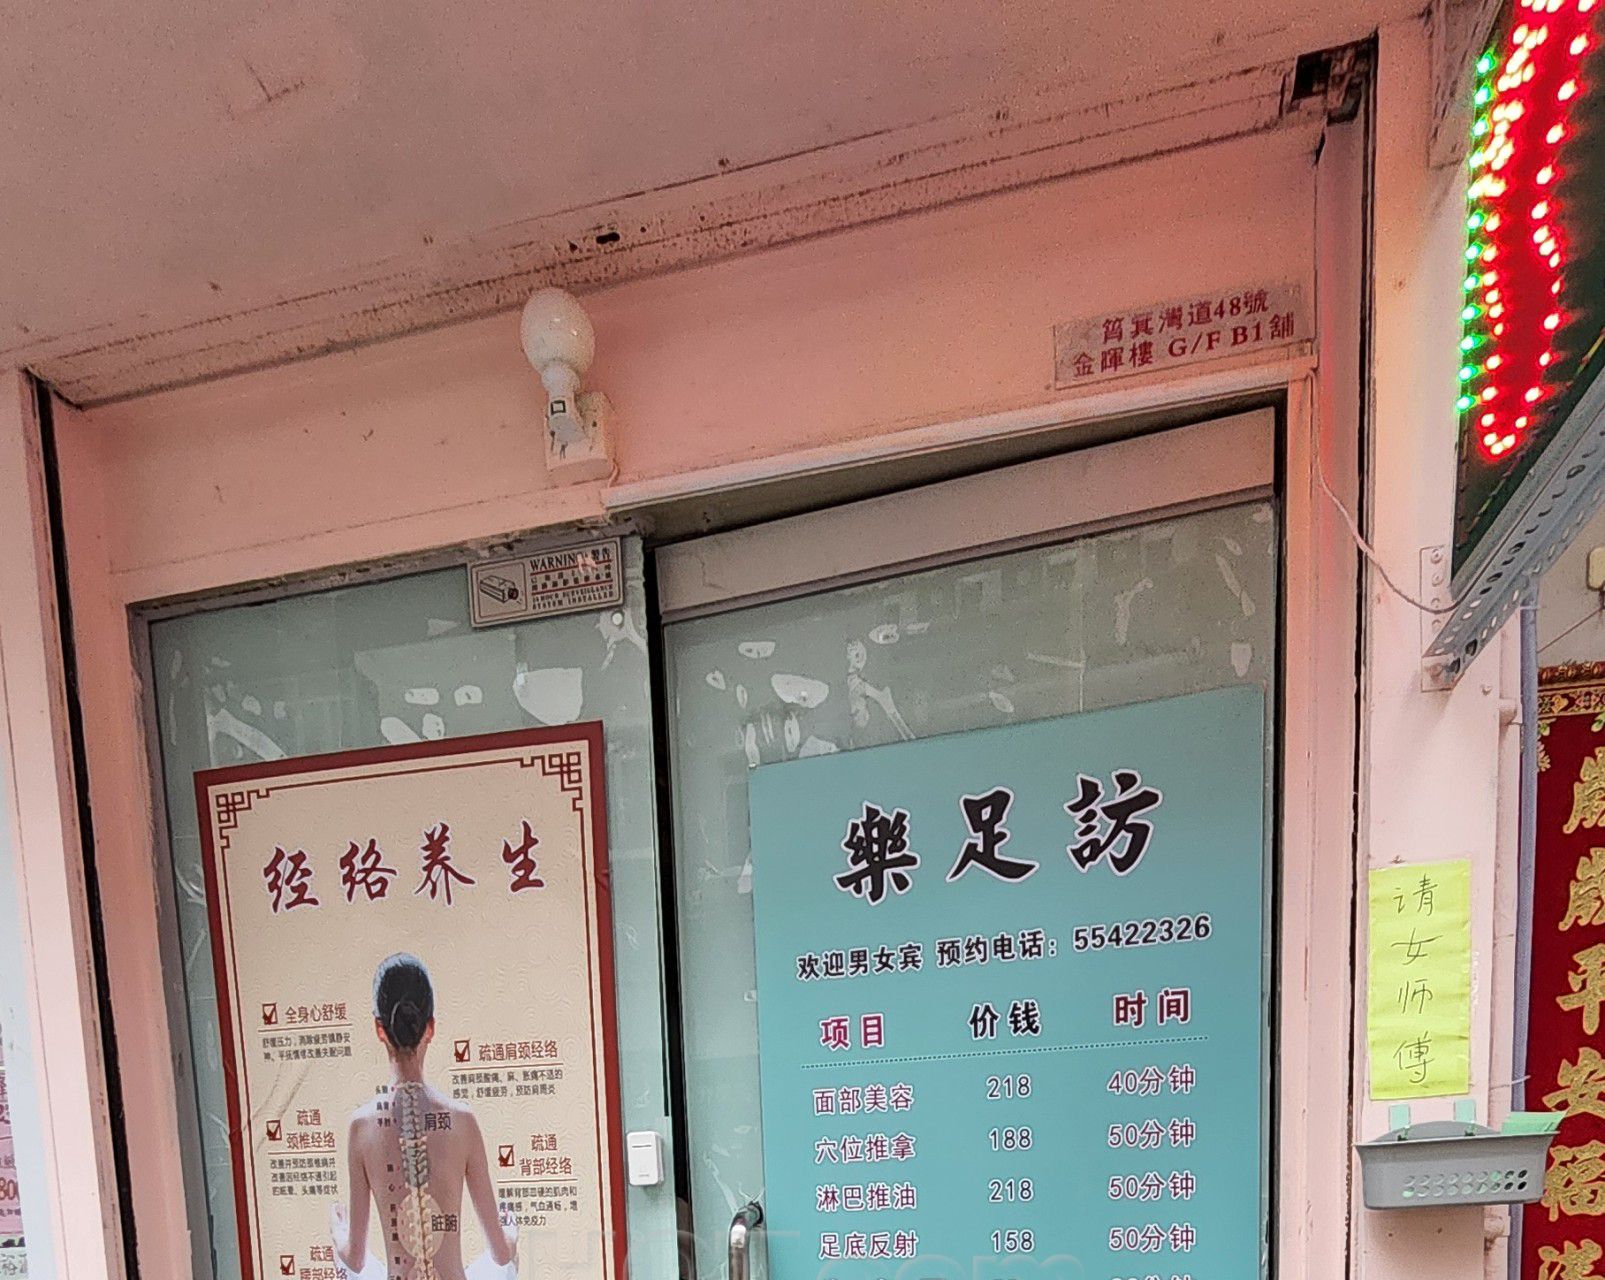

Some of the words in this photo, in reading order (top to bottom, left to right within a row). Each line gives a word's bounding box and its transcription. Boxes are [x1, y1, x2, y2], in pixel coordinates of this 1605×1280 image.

[1101, 288, 1270, 345] 筲箕灣道48號
[1072, 340, 1154, 378] 金暉樓
[1167, 330, 1221, 359] G/F
[832, 768, 1164, 906] 樂足訪
[262, 818, 546, 914] 经络养生
[796, 942, 924, 981] 欢迎男女宾
[1072, 913, 1212, 953] 55422326
[1390, 873, 1443, 1085] 请女师傅
[284, 1002, 348, 1024] 全身心舒缓
[818, 1013, 886, 1051] 项目
[968, 1000, 1043, 1040] 价钱
[1112, 987, 1191, 1028] 时间
[478, 1040, 559, 1062] 疏通肩颈经络
[812, 1083, 915, 1116] 面部美容
[985, 1074, 1032, 1099] 218
[1106, 1063, 1198, 1096] 40分钟
[296, 1108, 322, 1127] 疏通
[424, 1112, 452, 1131] 肩颈
[286, 1131, 336, 1150] 颈椎经络
[530, 1134, 558, 1152] 疏通
[814, 1132, 917, 1164] 穴位推拿
[988, 1127, 1034, 1152] 188
[1107, 1117, 1198, 1149] 50分钟
[519, 1158, 573, 1176] 背部经络
[816, 1182, 918, 1213] 淋巴推油
[988, 1178, 1035, 1204] 218
[1107, 1170, 1198, 1201] 50分钟
[431, 1214, 459, 1232] 脏腑
[818, 1230, 919, 1260] 足底反射
[990, 1229, 1036, 1253] 158
[1107, 1222, 1198, 1253] 50分钟
